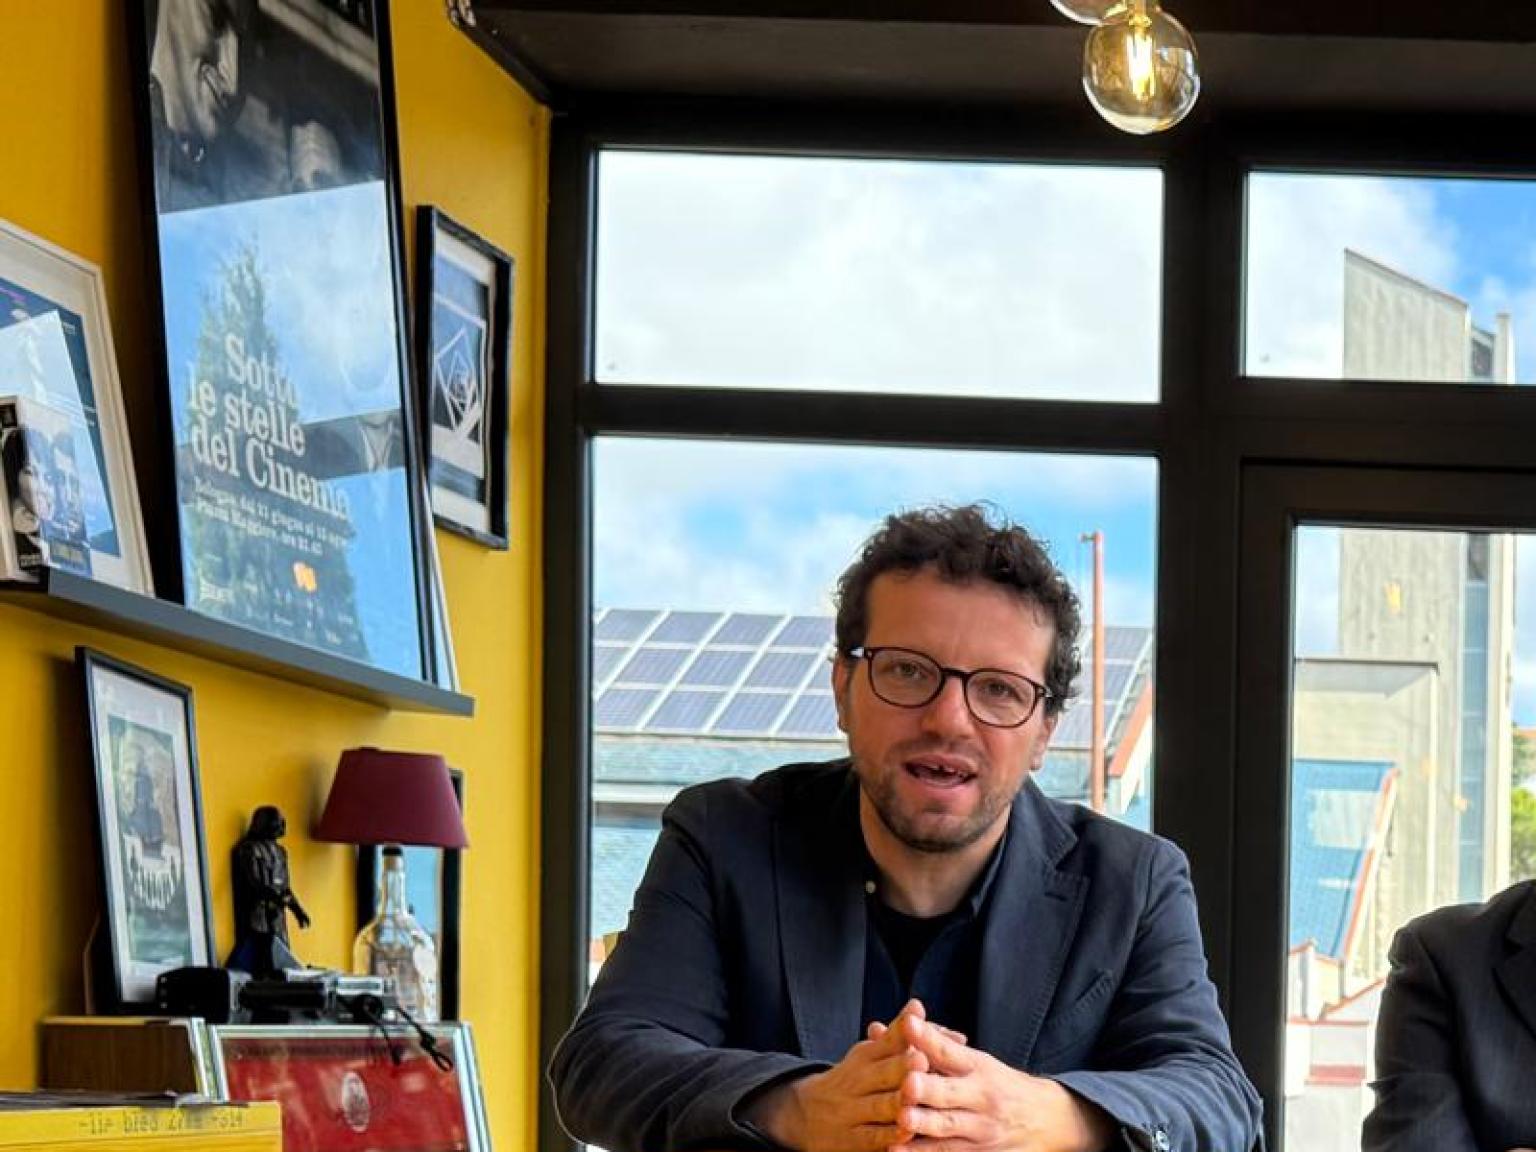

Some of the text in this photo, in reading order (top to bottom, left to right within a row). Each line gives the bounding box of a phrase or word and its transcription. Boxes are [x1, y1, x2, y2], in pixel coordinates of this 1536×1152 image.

[187, 361, 306, 458] le stelle
[191, 416, 241, 478] del
[246, 437, 348, 521] Cinema
